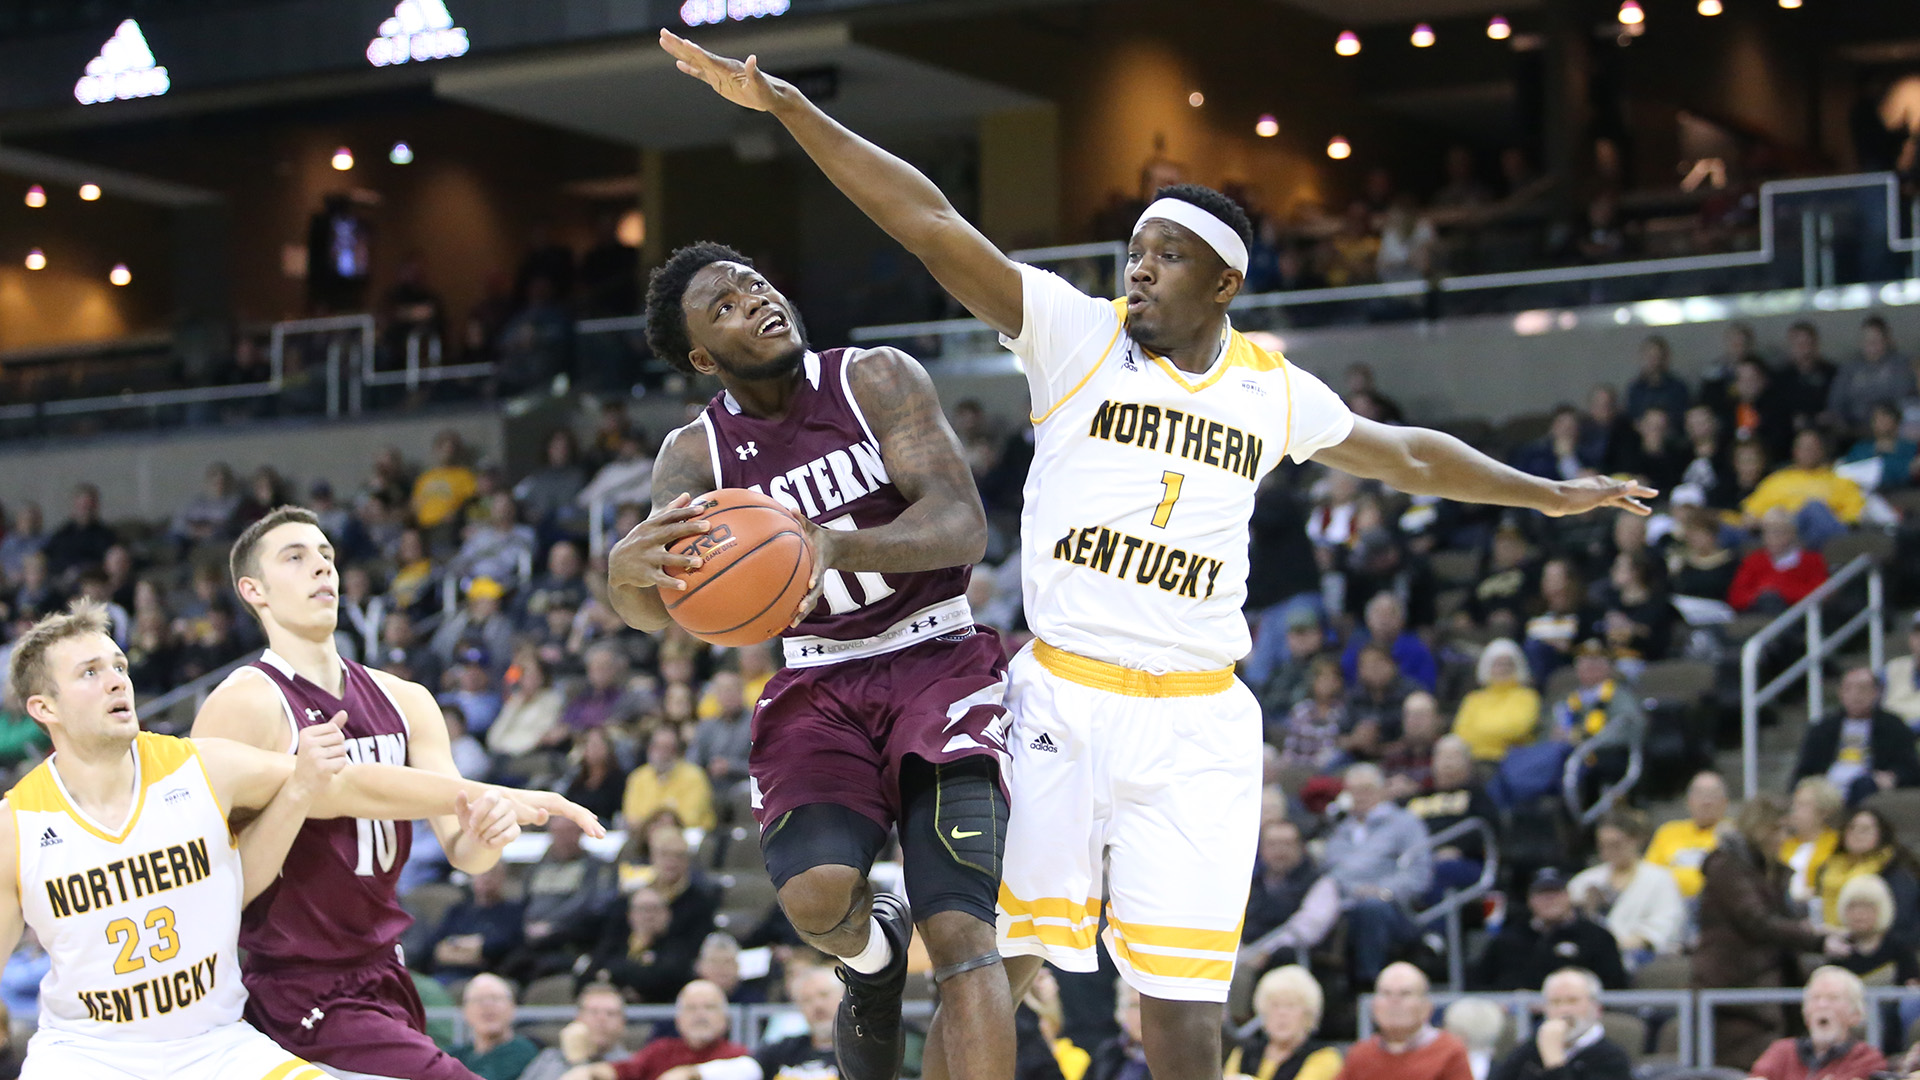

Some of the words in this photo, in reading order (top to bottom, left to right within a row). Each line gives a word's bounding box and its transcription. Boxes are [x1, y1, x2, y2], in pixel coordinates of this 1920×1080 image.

[1088, 399, 1263, 482] NORTHERN
[748, 440, 891, 519] STERN
[1150, 470, 1185, 529] 1
[1053, 526, 1225, 600] KENTUCKY
[45, 838, 211, 919] NORTHERN
[105, 906, 181, 975] 23
